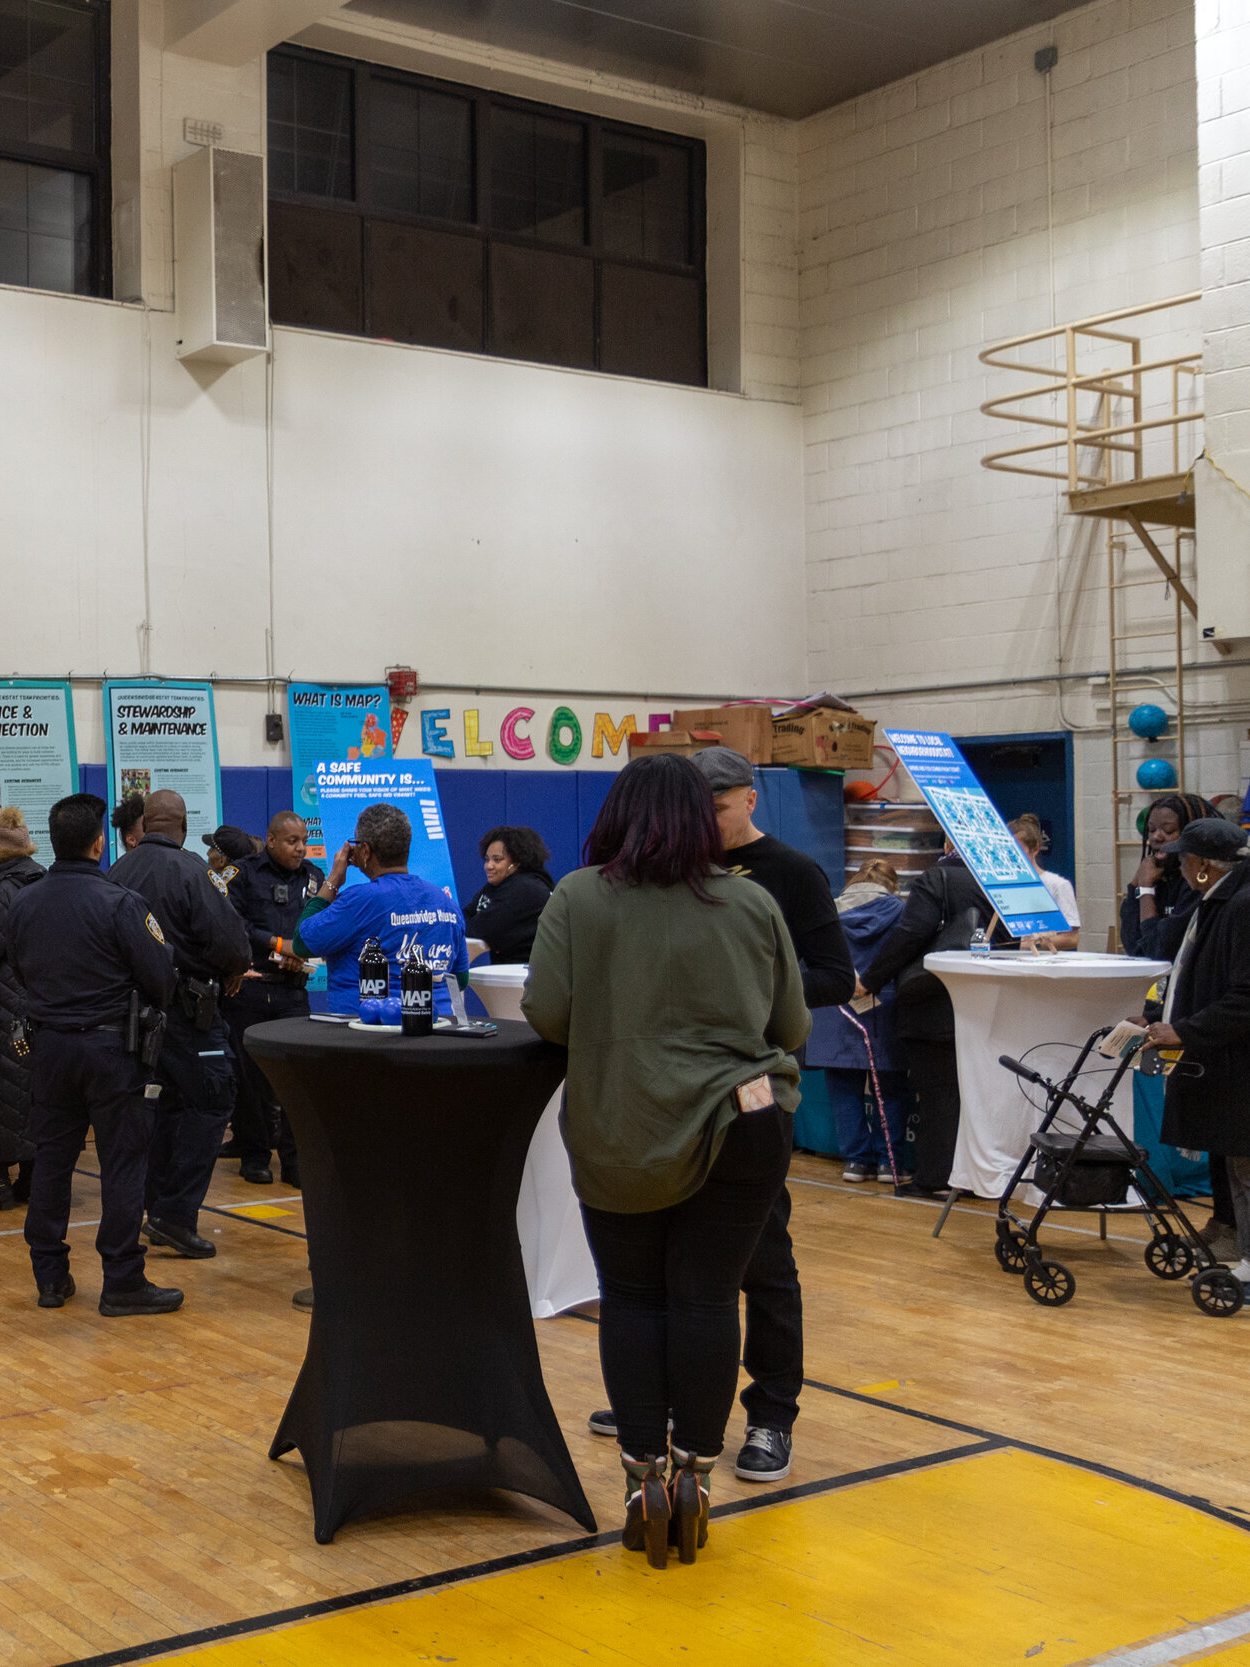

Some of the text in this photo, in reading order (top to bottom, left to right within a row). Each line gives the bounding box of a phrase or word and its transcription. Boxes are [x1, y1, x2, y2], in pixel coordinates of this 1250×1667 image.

[293, 692, 382, 709] WHAT IS MAP?
[23, 705, 33, 720] &
[117, 705, 196, 719] STEWARDSHIP
[118, 722, 207, 737] & MAINTENANCE
[316, 762, 362, 774] A SAFE
[318, 773, 425, 786] COMMUNITY IS...
[390, 910, 437, 926] Queensbridge
[428, 943, 453, 959] are
